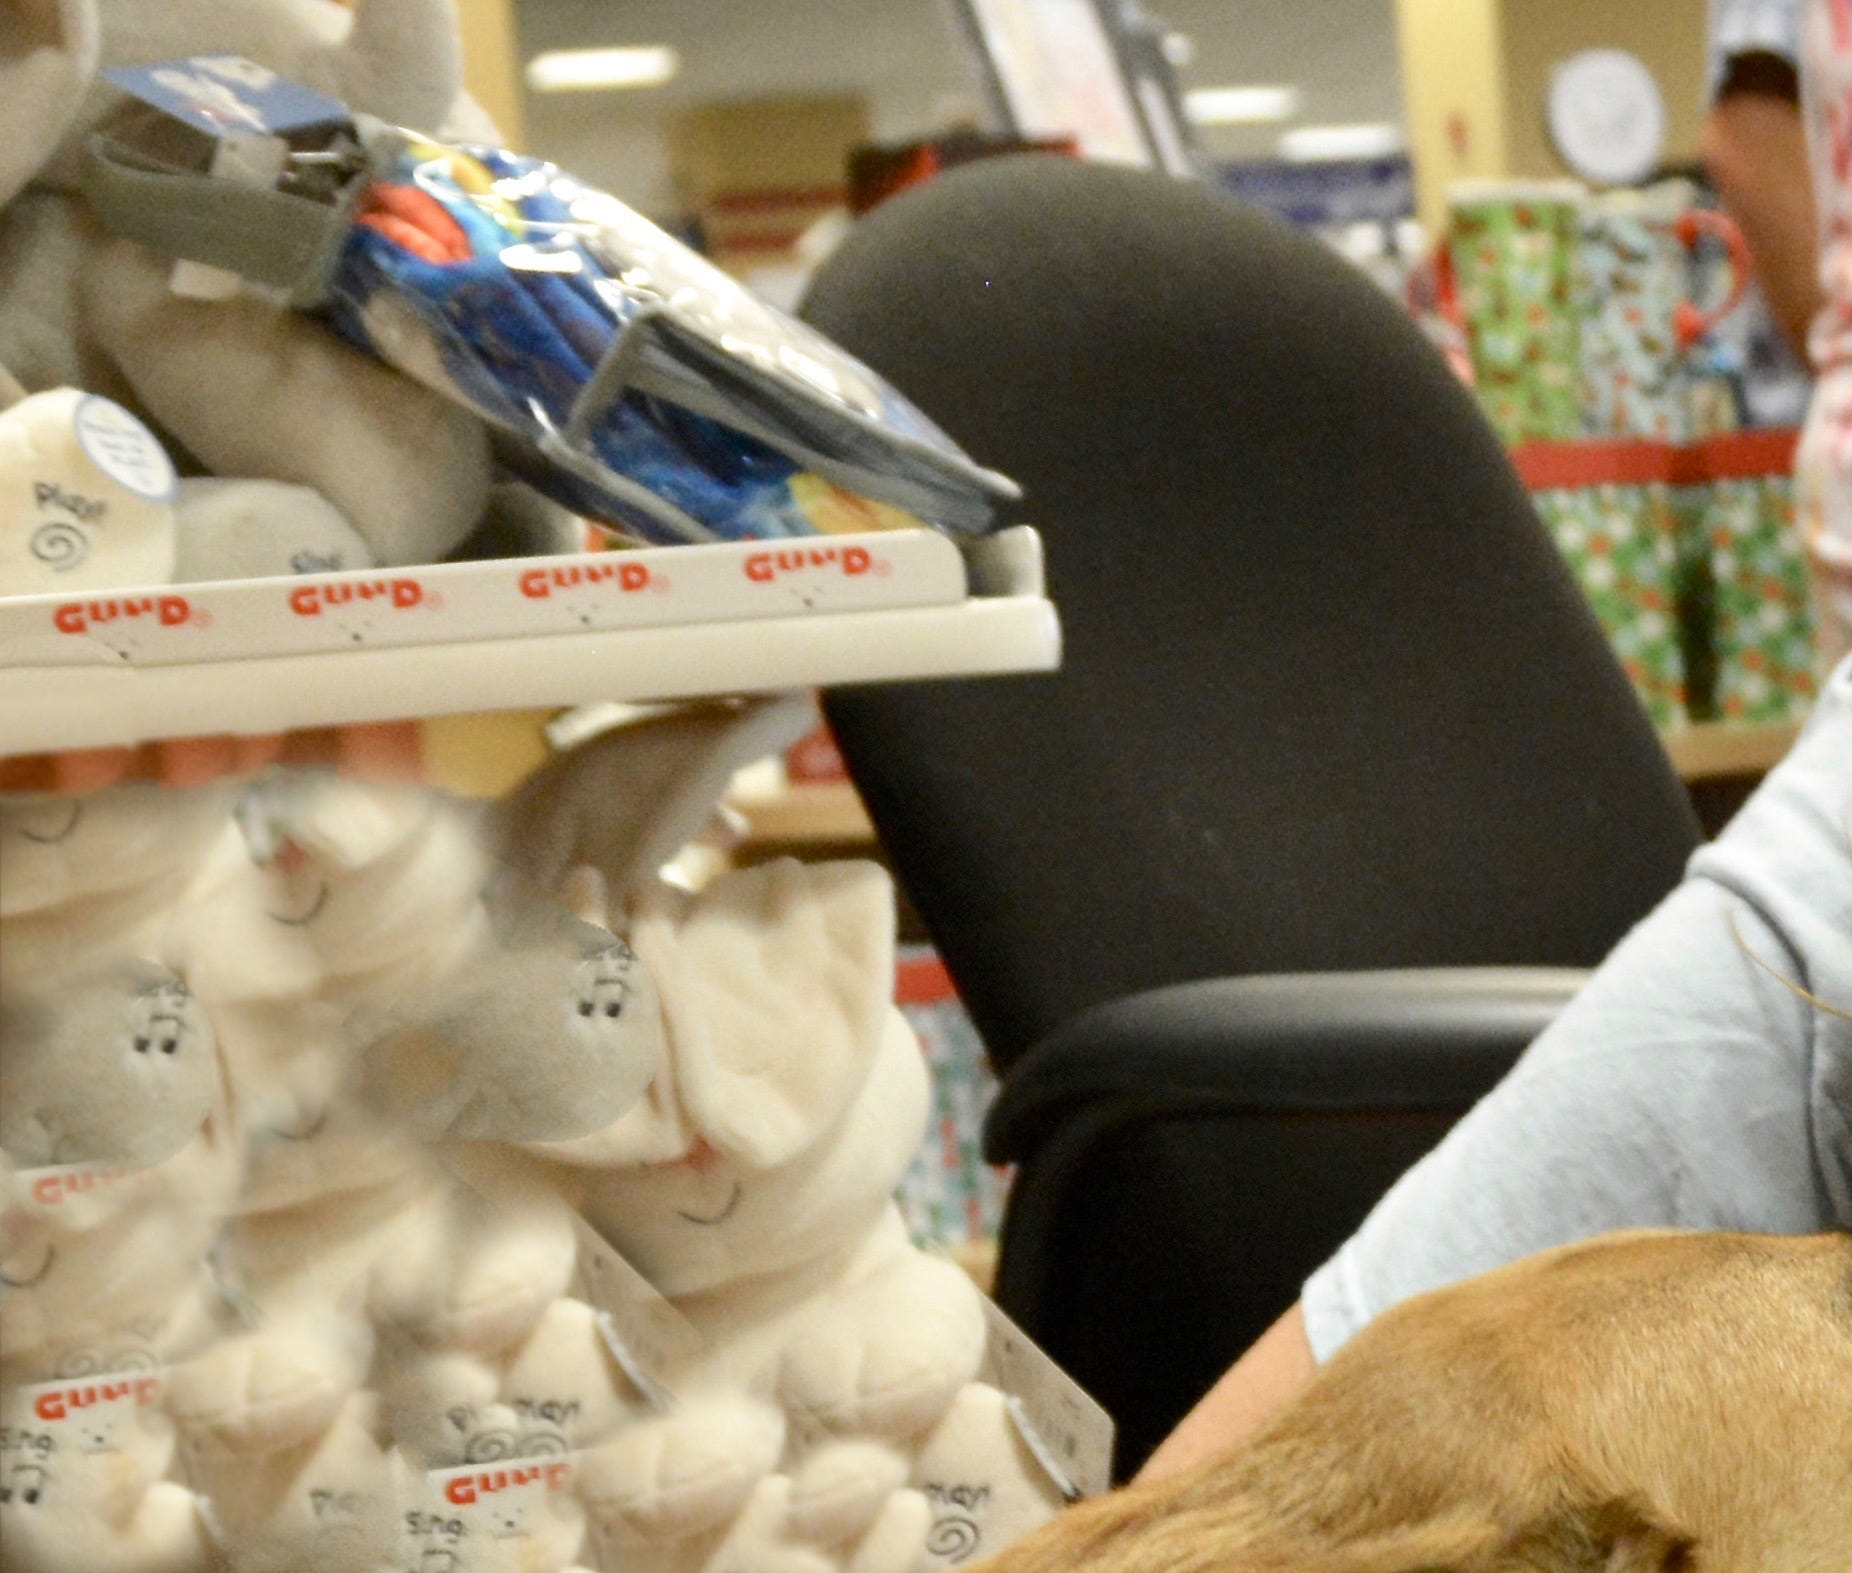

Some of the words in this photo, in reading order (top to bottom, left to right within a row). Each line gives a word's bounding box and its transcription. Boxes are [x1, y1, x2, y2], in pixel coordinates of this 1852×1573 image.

[53, 593, 191, 635] GUND
[288, 577, 424, 617] GUND
[519, 560, 651, 600] GUND
[743, 546, 873, 583] GUND
